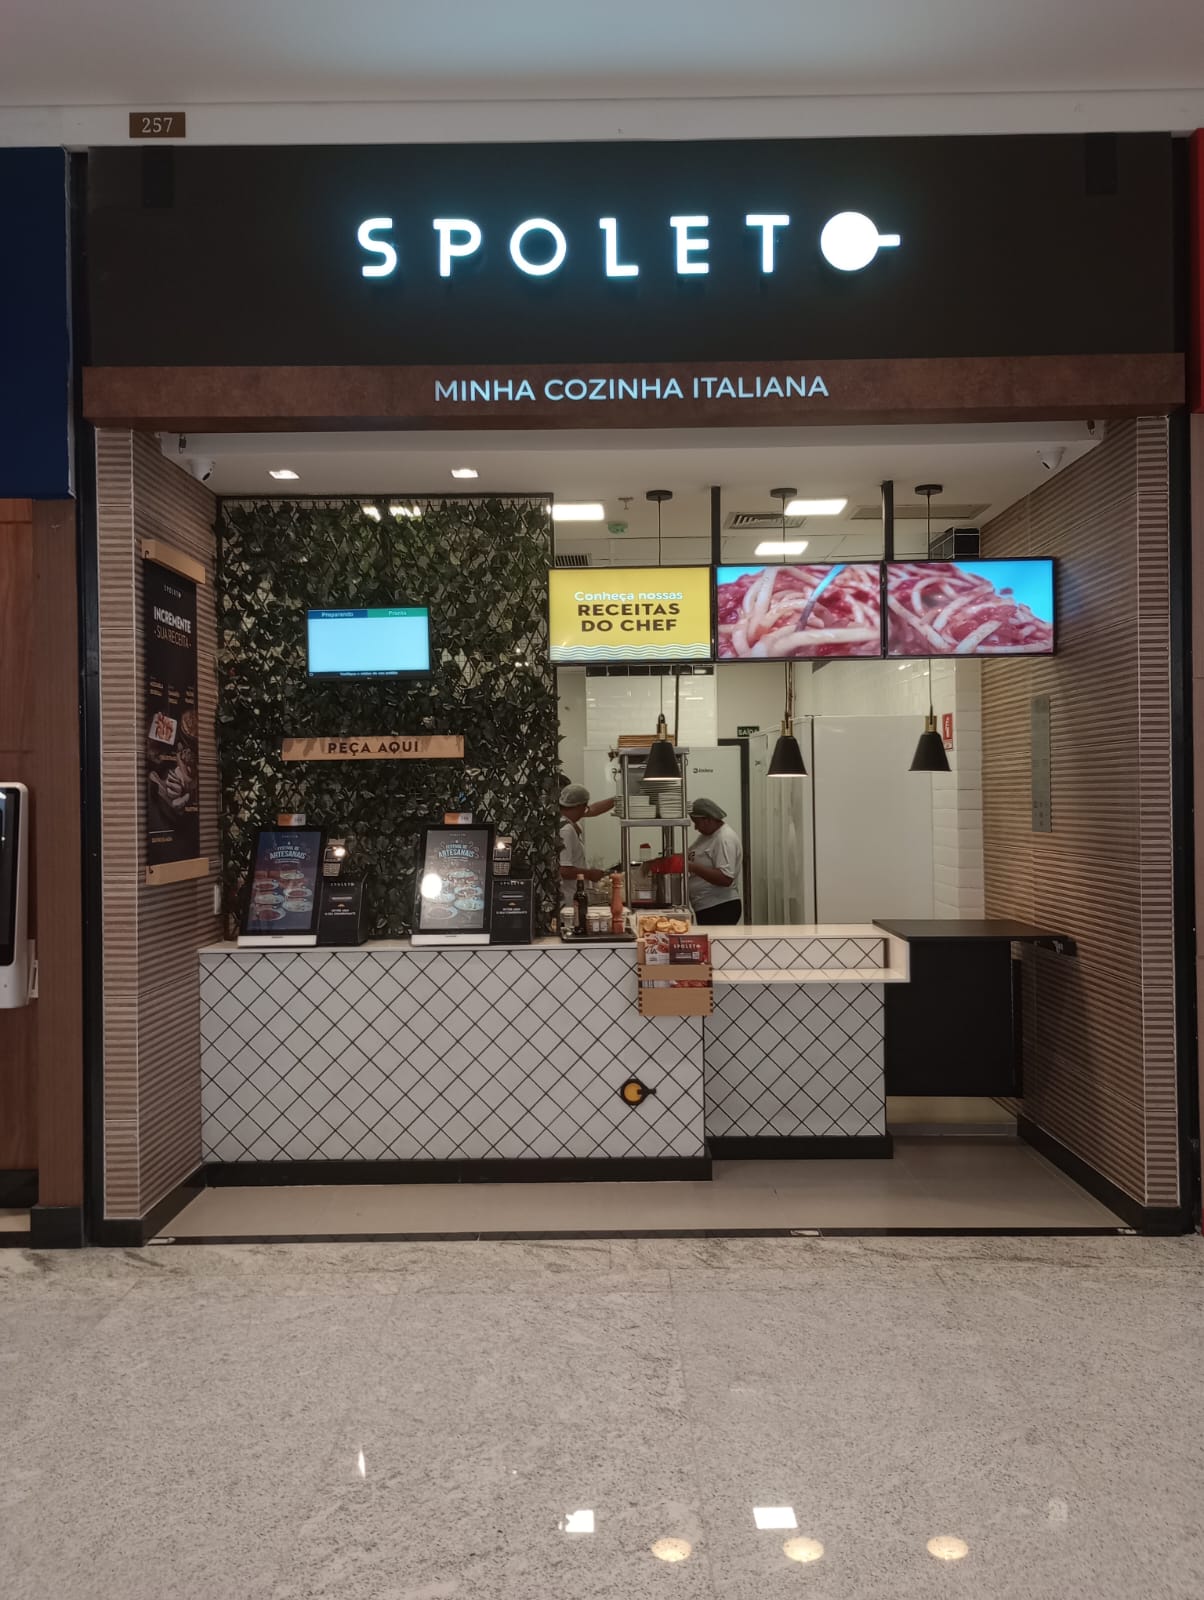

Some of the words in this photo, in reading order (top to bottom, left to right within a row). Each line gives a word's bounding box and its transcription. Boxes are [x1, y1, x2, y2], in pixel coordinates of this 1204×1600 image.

[141, 117, 173, 133] 257
[434, 379, 536, 401] MINHA
[544, 377, 684, 400] COZINHA
[693, 375, 829, 399] ITALIANA
[574, 591, 634, 602] Conheça
[638, 591, 683, 600] nossas
[578, 603, 680, 616] RECEITAS
[154, 606, 191, 634] INCREMENTE
[581, 619, 613, 632] DO
[620, 619, 677, 631] CHEF
[327, 742, 371, 756] PEÇA
[377, 741, 419, 754] AQUI
[269, 850, 307, 860] ARTESANAIS
[438, 848, 475, 858] ARTESANAIS
